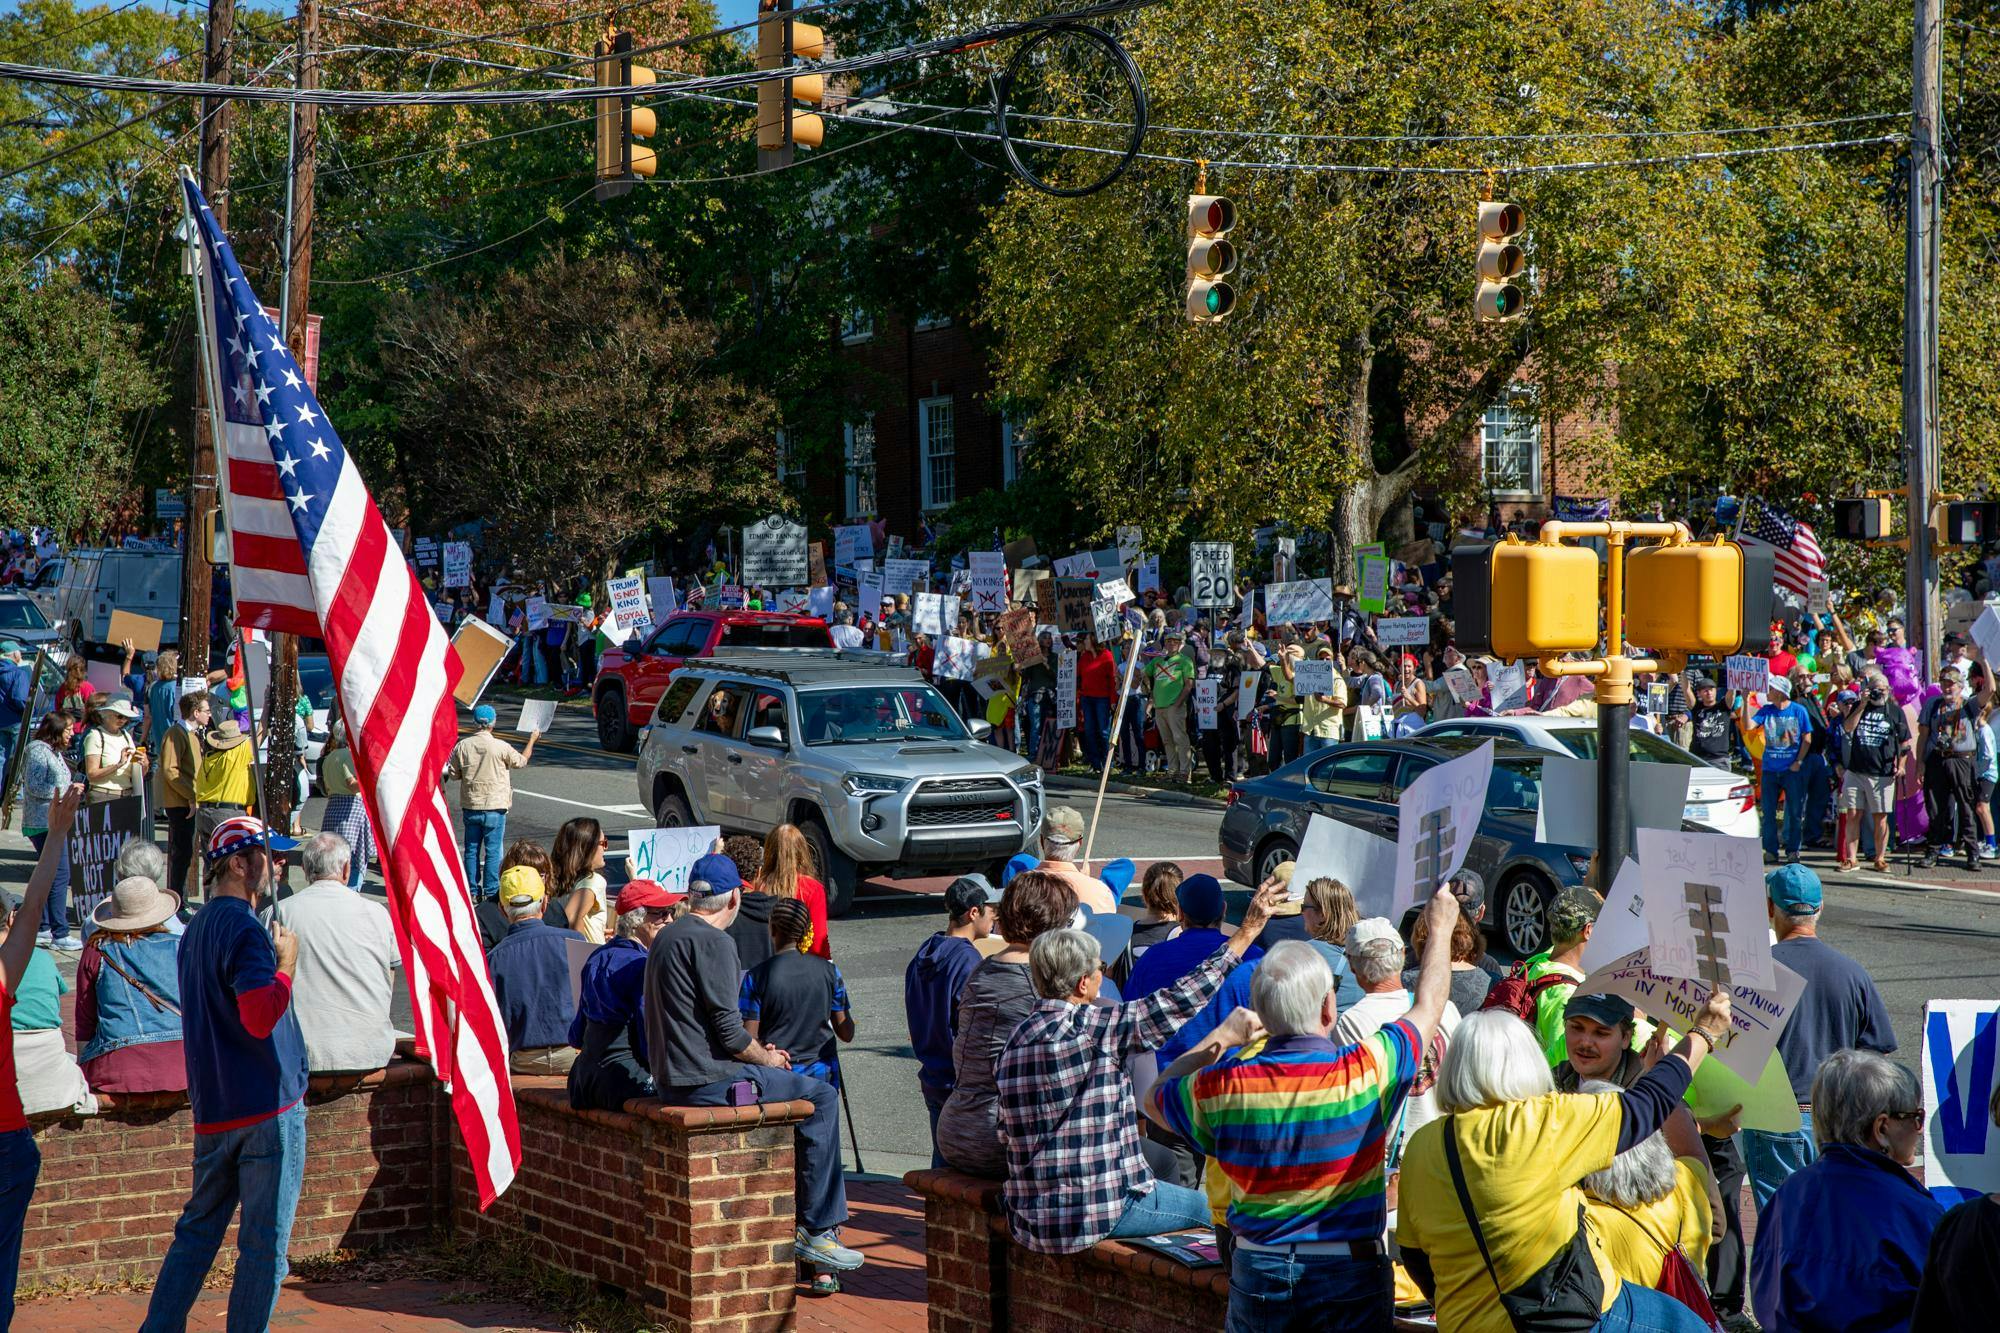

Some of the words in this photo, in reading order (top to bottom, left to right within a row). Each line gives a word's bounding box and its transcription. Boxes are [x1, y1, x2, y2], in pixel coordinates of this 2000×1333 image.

[1195, 550, 1230, 560] SPEED
[1199, 563, 1227, 573] LIMIT
[754, 574, 773, 582] nearby
[972, 577, 983, 586] NO
[983, 577, 1004, 587] KINGS
[610, 579, 639, 591] TRUMP
[1197, 576, 1229, 600] 20
[614, 592, 622, 600] IS
[623, 588, 640, 599] NOT
[617, 598, 640, 609] KING
[1095, 601, 1113, 615] NO
[617, 610, 645, 622] ROYAL
[632, 617, 649, 626] ASS
[1096, 614, 1118, 630] KINGS
[1071, 621, 1087, 631] USA
[1392, 622, 1406, 630] Hating
[1406, 621, 1427, 632] Diversity
[1728, 656, 1753, 671] WAKE
[1755, 658, 1767, 672] UP
[1064, 669, 1073, 679] NOT
[1728, 670, 1767, 693] AMERICA
[1201, 687, 1209, 695] NO
[1297, 682, 1316, 694] ONLY
[1197, 696, 1214, 704] KINGS
[949, 793, 985, 801] TOYOTA
[75, 807, 90, 837] I'M
[103, 803, 112, 832] A
[83, 863, 104, 894] NOT
[1642, 968, 1673, 985] Have
[1678, 979, 1689, 995] A
[1626, 958, 1647, 968] IN
[1734, 985, 1784, 1018] OPINION
[1634, 980, 1656, 996] IN
